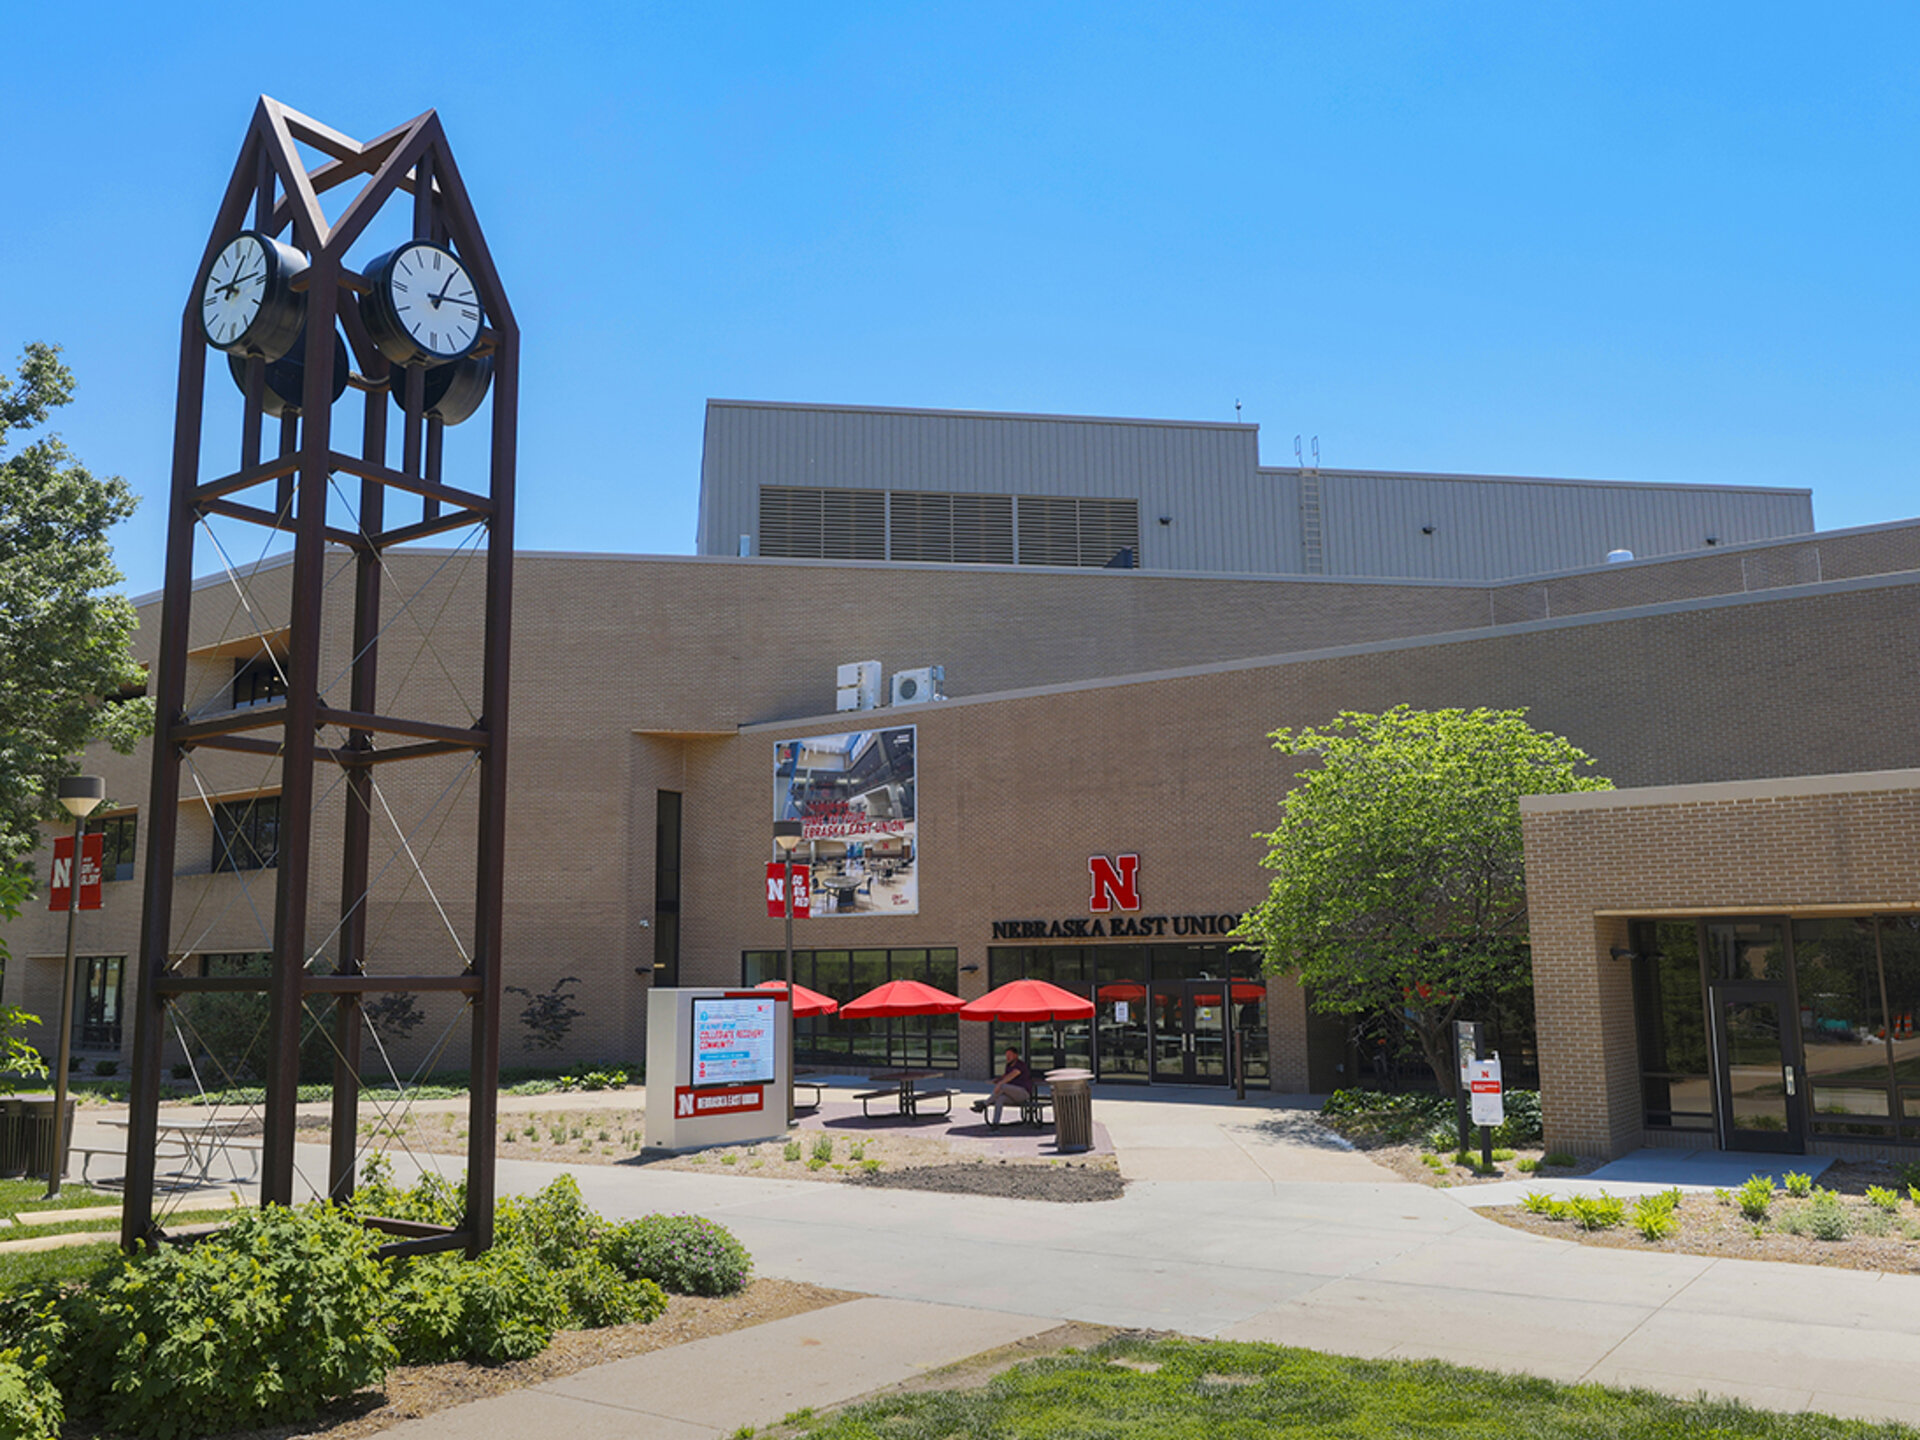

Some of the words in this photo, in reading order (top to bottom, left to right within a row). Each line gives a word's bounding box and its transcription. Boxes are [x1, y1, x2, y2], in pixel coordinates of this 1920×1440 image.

[803, 823, 846, 839] EBRASKA
[52, 858, 72, 888] N
[792, 875, 803, 885] GO
[1088, 854, 1141, 913] N
[768, 878, 784, 901] N
[794, 886, 806, 897] BIG
[795, 897, 809, 907] RED
[992, 918, 1106, 939] NEBRASKA
[1109, 915, 1169, 936] EAST
[1171, 913, 1250, 935] UNIO
[678, 1094, 694, 1116] N
